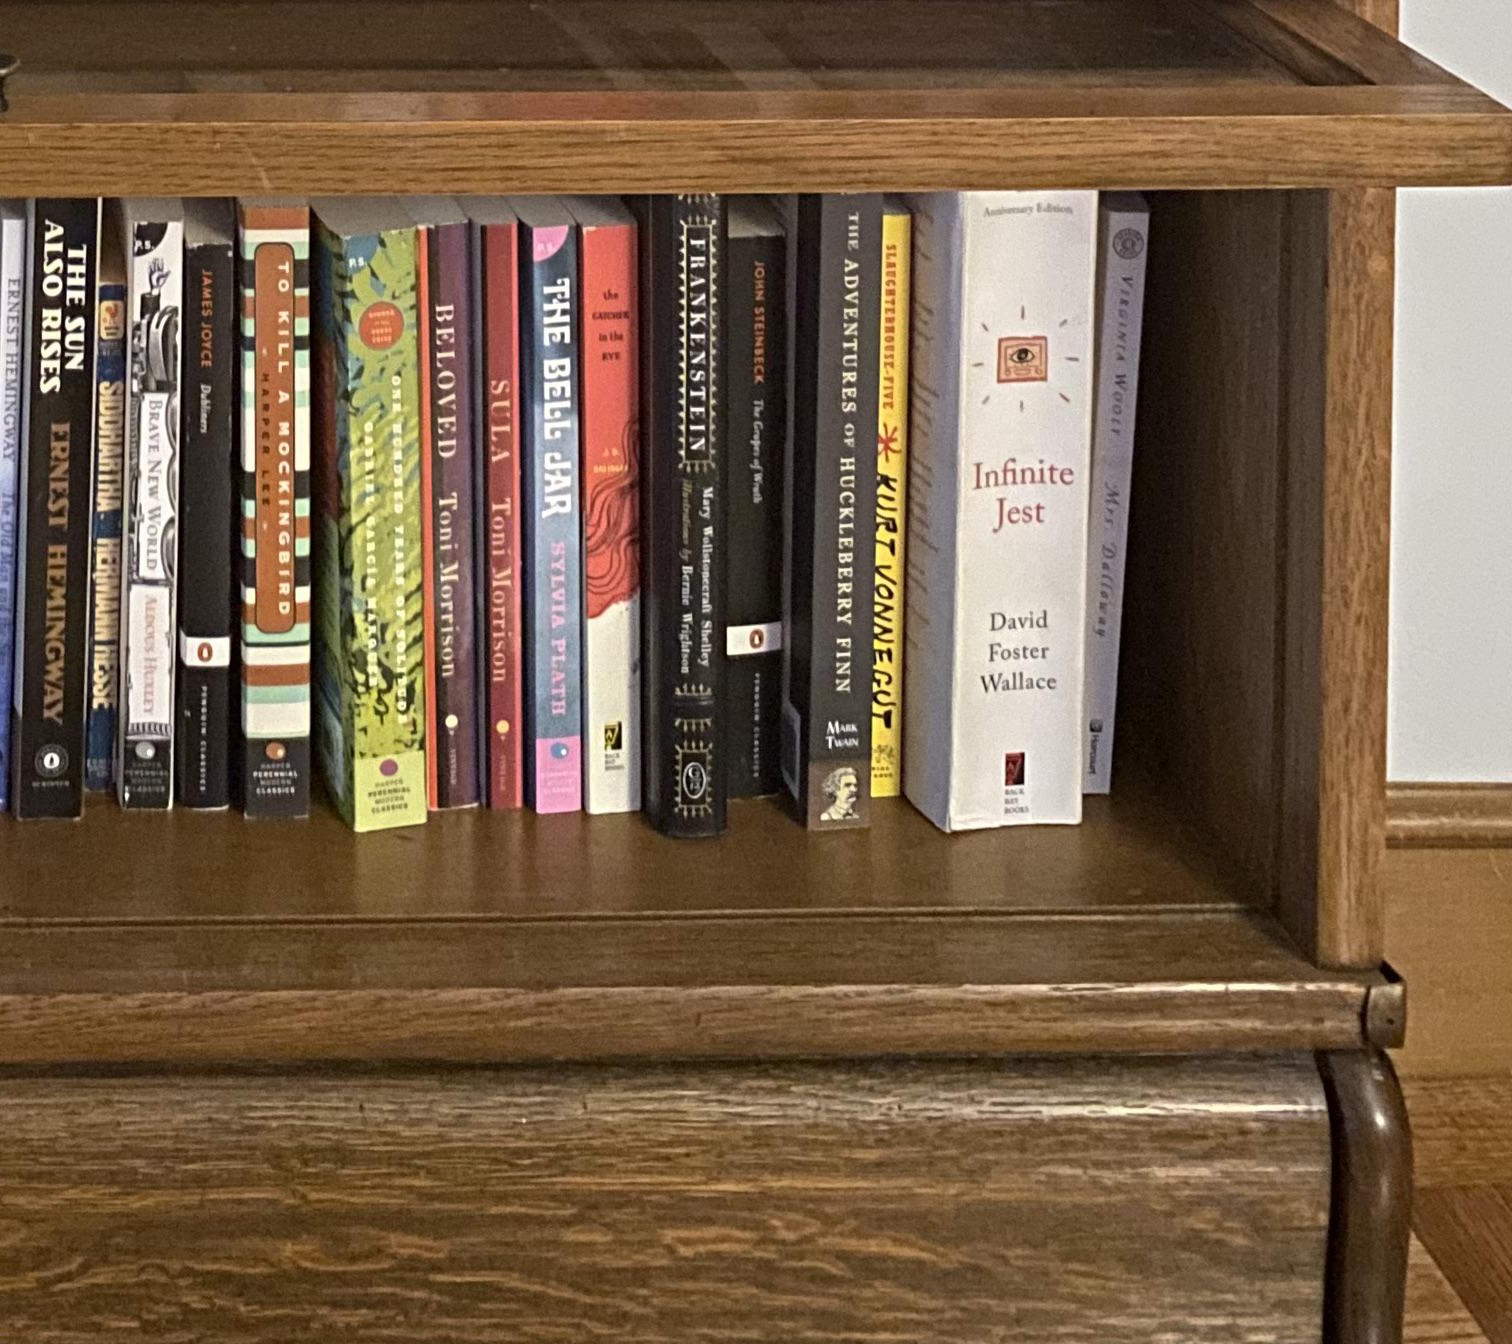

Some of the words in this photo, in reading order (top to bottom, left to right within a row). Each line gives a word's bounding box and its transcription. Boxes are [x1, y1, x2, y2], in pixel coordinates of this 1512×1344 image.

[41, 218, 65, 298] ALSO
[66, 243, 88, 308] THE
[64, 314, 86, 371] SUN
[277, 310, 291, 374] KILL
[543, 277, 571, 347] THE
[688, 239, 707, 452] FRANKENSTEIN
[841, 258, 860, 414] ADVENTURES
[882, 244, 897, 411] SLAUGHTERHOUSE-FIVE
[40, 307, 63, 395] RISES
[434, 303, 457, 460] BELOVED
[148, 399, 163, 454] BRAVE
[542, 358, 572, 441] BELL
[97, 380, 125, 512] SIDDHARTHA
[973, 458, 1075, 491] Infinite
[147, 461, 162, 504] NEW
[541, 451, 573, 520] JAR
[874, 472, 898, 557] KURT
[992, 497, 1046, 533] Jest
[146, 508, 163, 571] WORLD
[277, 422, 291, 615] MOCKINGBIRD
[438, 491, 459, 551] Toni
[837, 456, 856, 626] HUCKLEBERRY
[439, 561, 460, 679] Morrison
[872, 563, 898, 730] VONNEGUT
[988, 642, 1050, 663] Foster
[989, 610, 1049, 632] David
[834, 637, 852, 694] FINN
[980, 672, 1058, 694] Wallace
